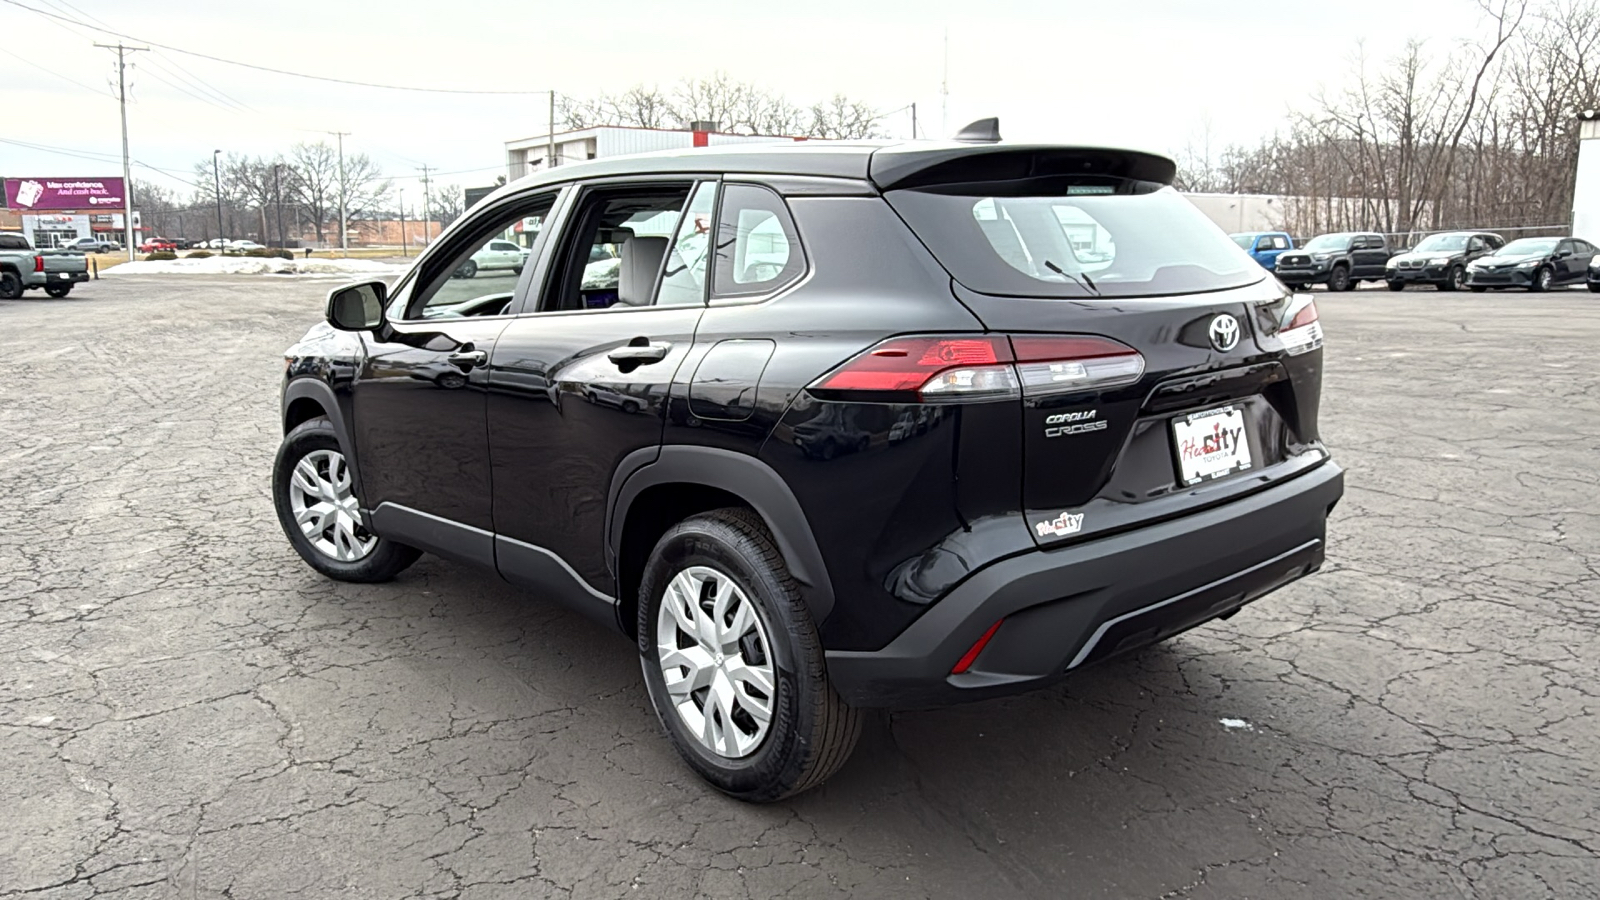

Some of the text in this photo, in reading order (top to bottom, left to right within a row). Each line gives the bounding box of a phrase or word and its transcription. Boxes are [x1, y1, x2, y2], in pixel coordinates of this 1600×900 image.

[1046, 409, 1097, 424] COROLLA
[1045, 420, 1107, 437] CROSS
[1202, 451, 1229, 463] TOYOTA
